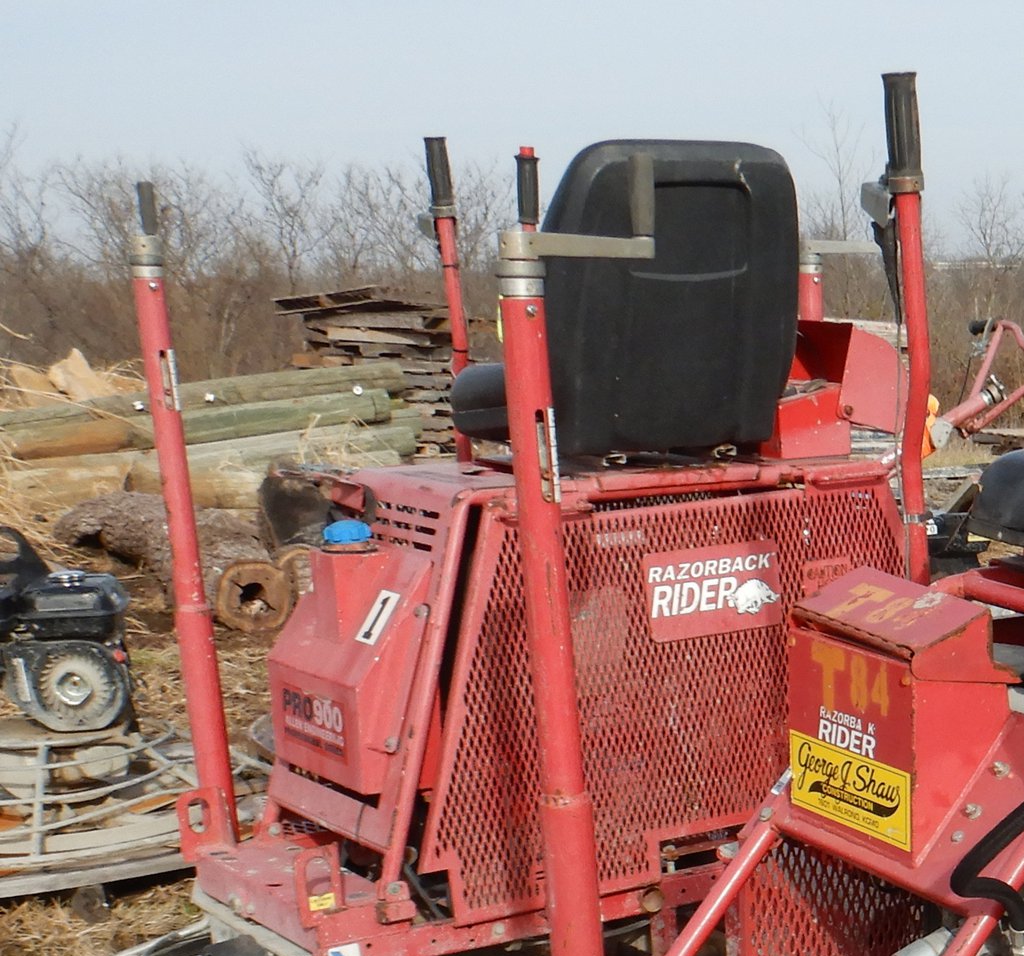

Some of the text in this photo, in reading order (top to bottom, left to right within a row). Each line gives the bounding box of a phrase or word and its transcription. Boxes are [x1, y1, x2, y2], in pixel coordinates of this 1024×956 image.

[647, 553, 771, 584] RAZORBACK
[651, 576, 739, 619] RIDER
[819, 705, 876, 736] RAZORBAK
[817, 718, 877, 760] RIDER
[797, 741, 840, 799] George
[852, 764, 901, 806] Shaw
[821, 782, 875, 812] CONSTRUCTION
